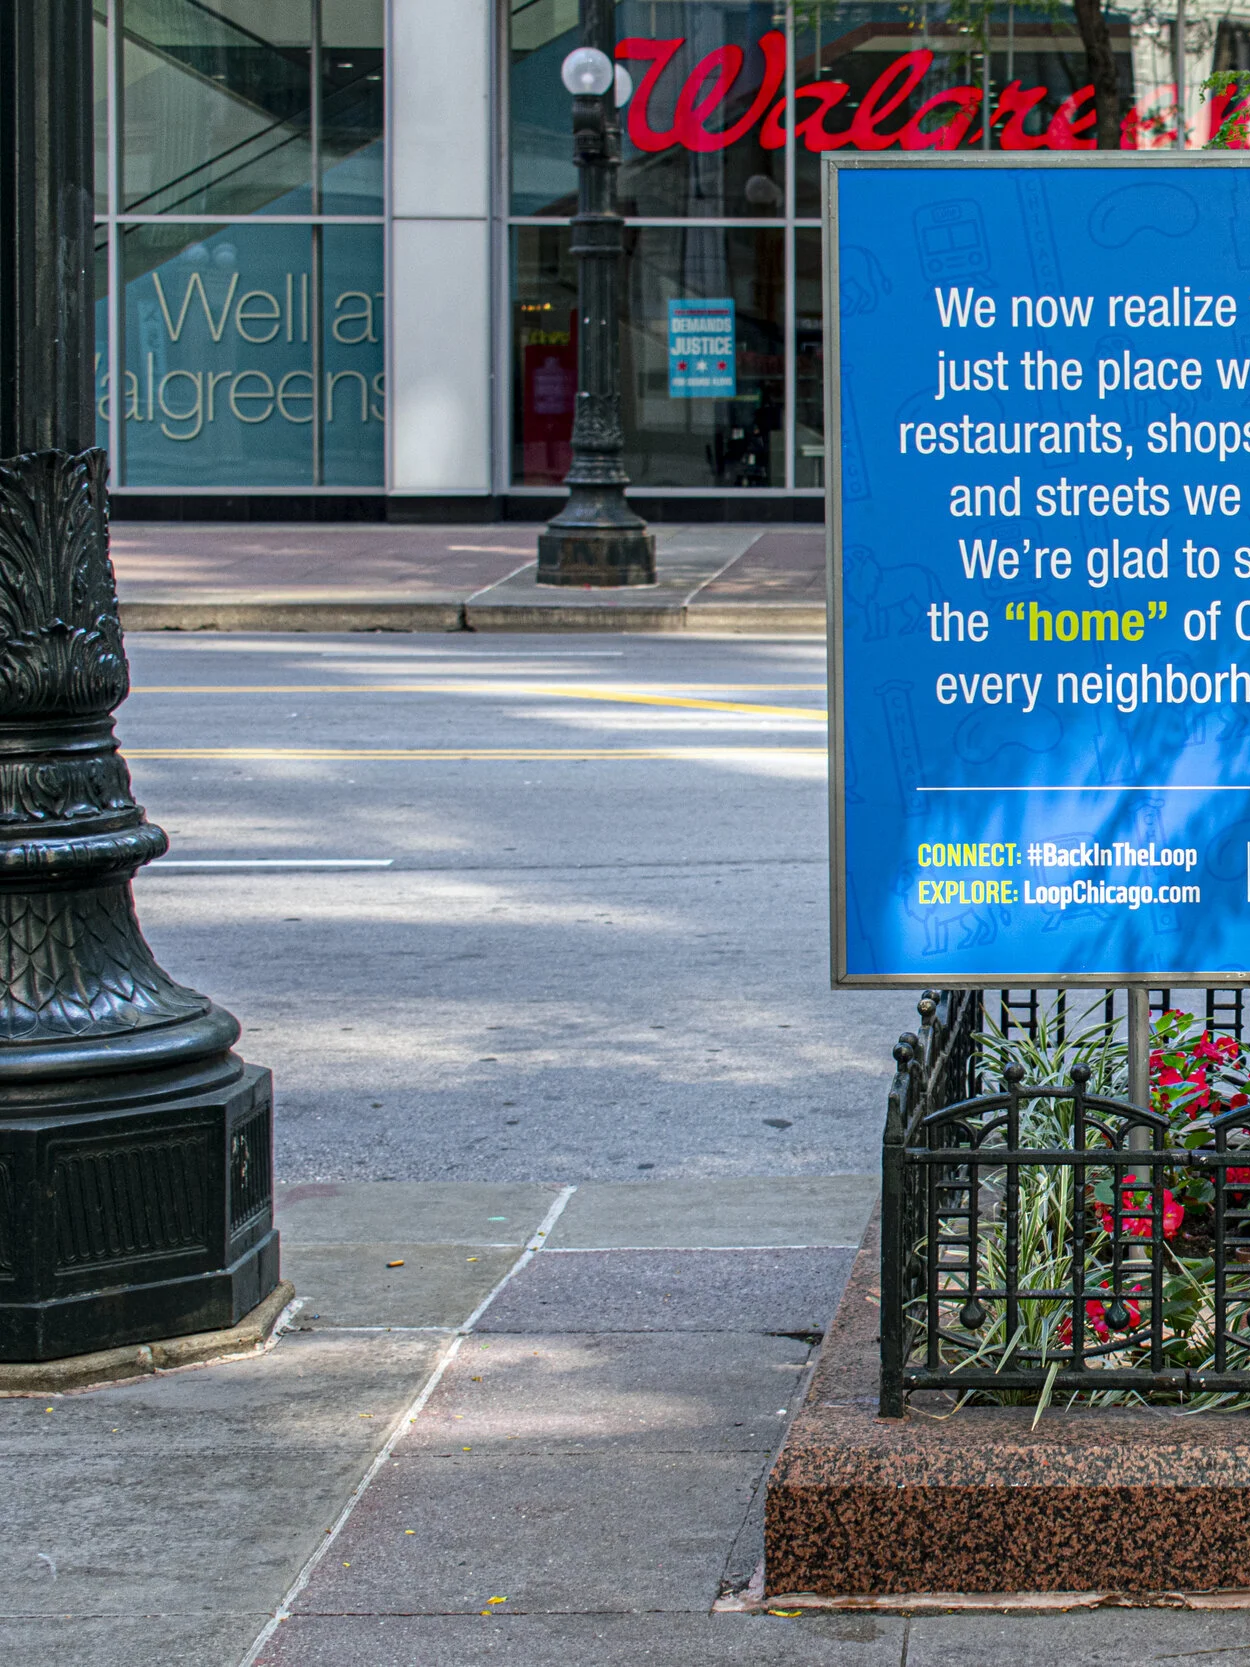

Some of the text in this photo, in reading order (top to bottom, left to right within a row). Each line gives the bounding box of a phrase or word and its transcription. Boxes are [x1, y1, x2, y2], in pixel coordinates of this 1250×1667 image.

[151, 271, 309, 344] Well
[332, 290, 385, 344] a
[671, 317, 732, 333] DEMANDS
[934, 287, 996, 328] We
[1011, 295, 1094, 328] now
[1109, 286, 1237, 327] realize
[670, 336, 733, 356] JUSTICE
[95, 351, 385, 440] algreens
[934, 350, 1009, 401] just
[1020, 350, 1083, 391] the
[1098, 349, 1202, 399] place
[900, 414, 1133, 461] restaurants,
[949, 476, 1021, 517] and
[1036, 476, 1170, 517] streets
[1183, 484, 1241, 516] we
[958, 539, 1072, 580] We’re
[1087, 538, 1168, 588] glad
[1182, 539, 1220, 579] to
[926, 601, 989, 642] the
[1005, 601, 1167, 642] “home”
[1183, 600, 1221, 641] of
[936, 673, 1043, 713] every
[918, 841, 1197, 872] CONNECT: #BackInTheLoop
[918, 879, 1201, 910] EXPLORE: LoopChicago.com
